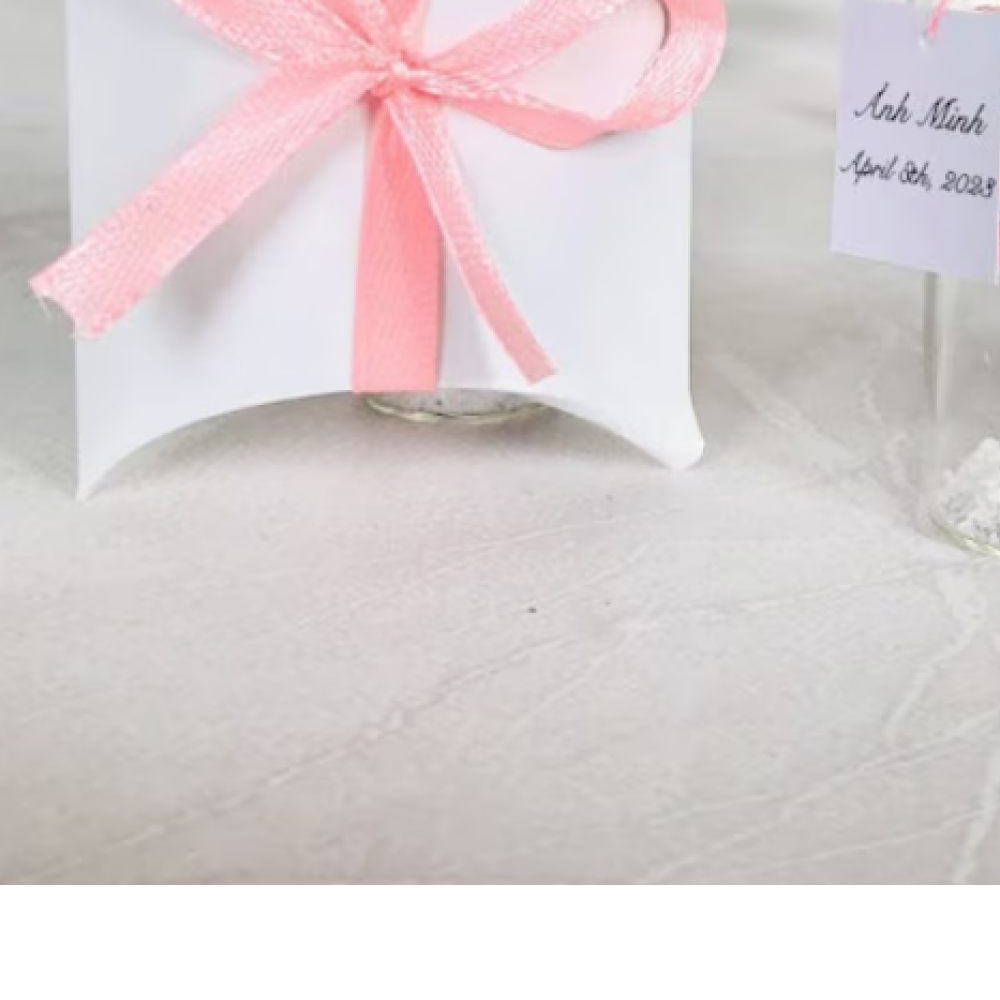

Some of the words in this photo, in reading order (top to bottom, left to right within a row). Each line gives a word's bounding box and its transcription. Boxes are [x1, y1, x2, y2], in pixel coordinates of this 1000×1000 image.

[915, 96, 989, 136] Minh
[839, 150, 898, 185] April
[939, 170, 997, 199] 2023
